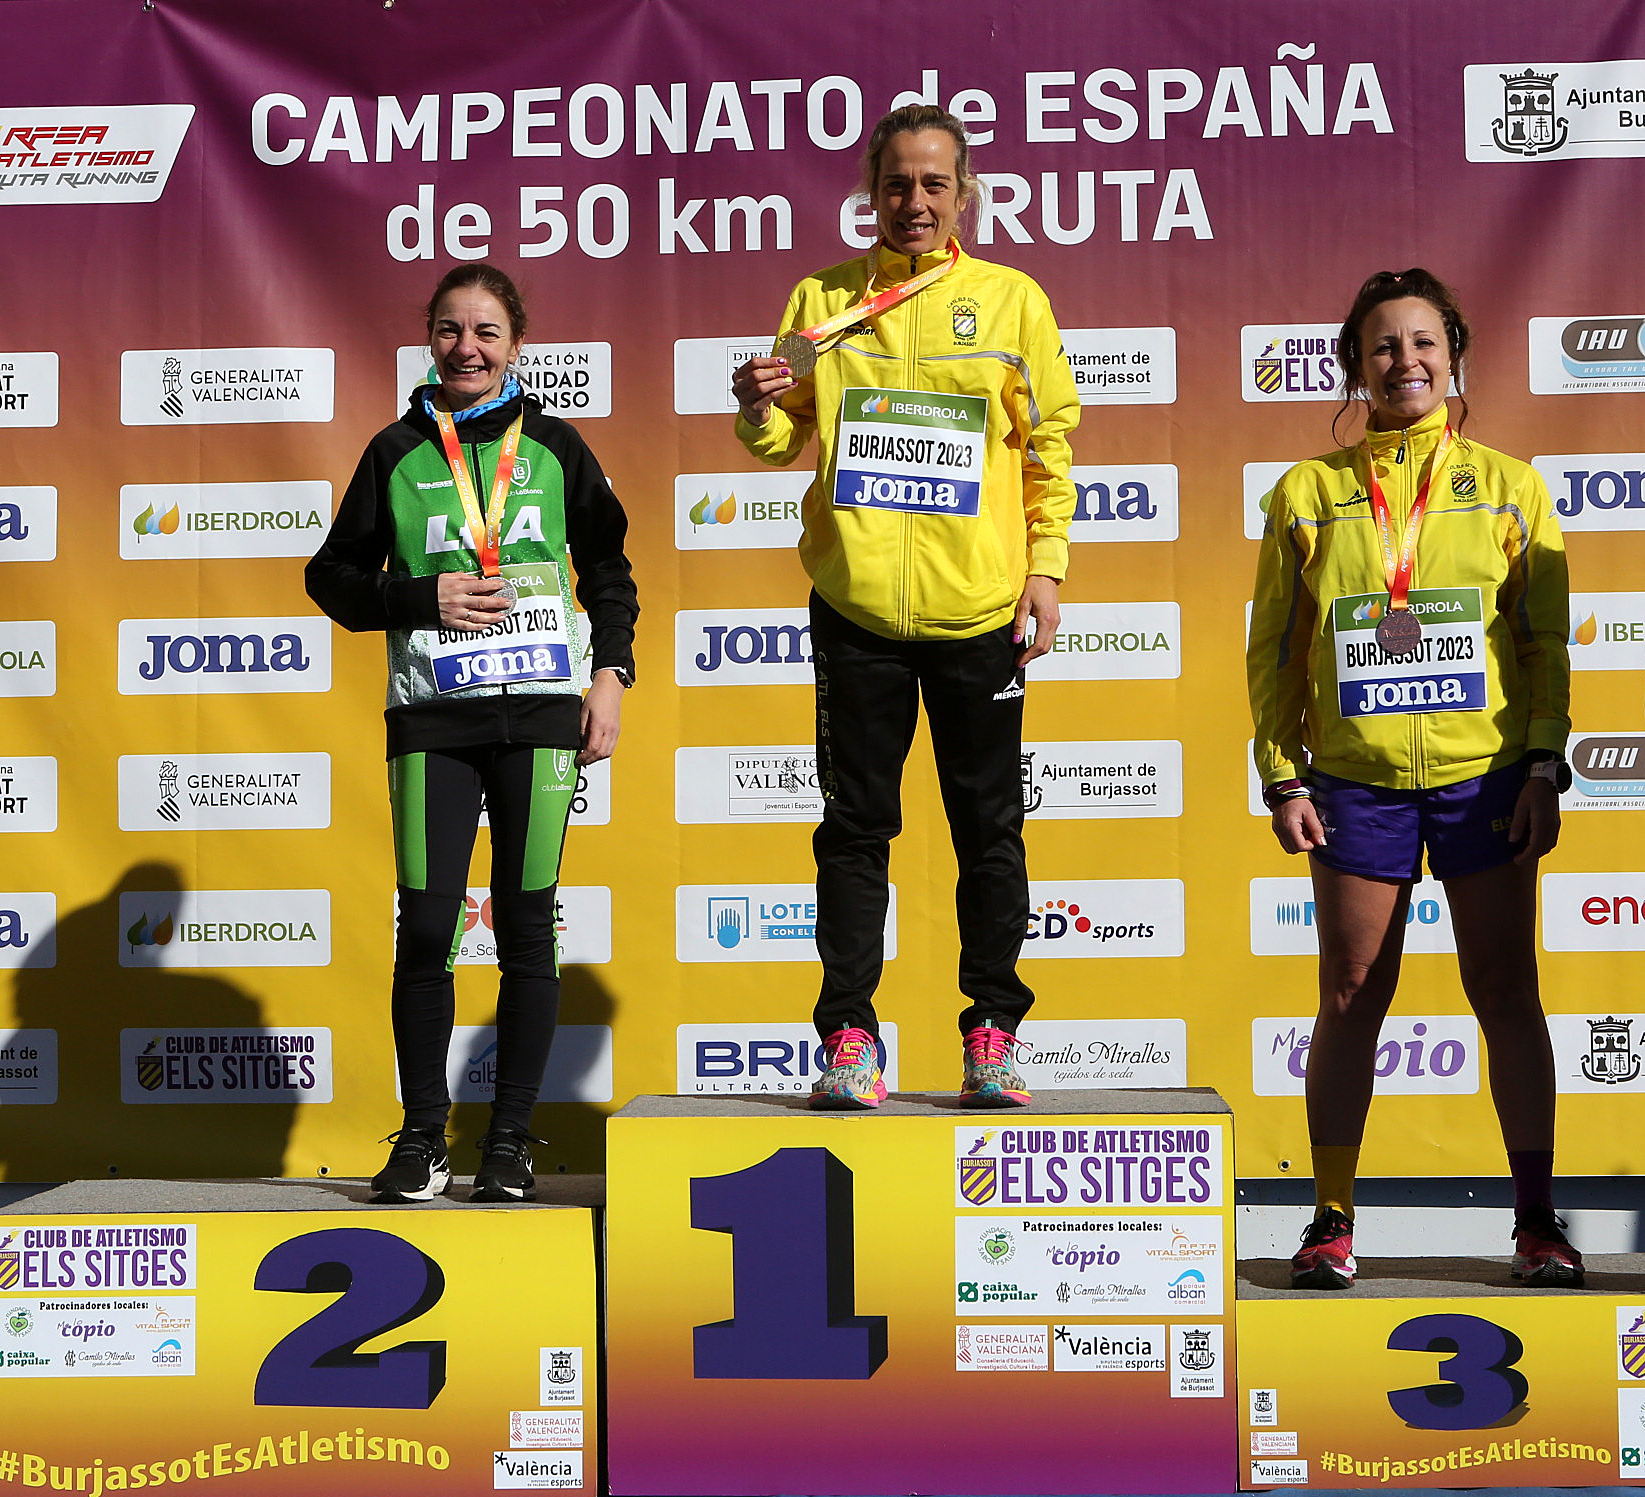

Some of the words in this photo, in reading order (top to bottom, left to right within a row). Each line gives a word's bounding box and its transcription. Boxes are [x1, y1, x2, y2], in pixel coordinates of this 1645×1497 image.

[251, 75, 863, 167] CAMPEONATO
[1025, 42, 1395, 144] ESPAÑA
[2, 125, 110, 151] RFEA
[56, 171, 159, 189] RUNNING
[386, 184, 492, 263] de
[518, 183, 630, 260] 50
[658, 178, 794, 255] km
[976, 168, 1215, 246] RUTA
[1285, 338, 1327, 355] CLUB
[1576, 328, 1628, 351] IAU
[519, 351, 589, 366] DACIÓN
[1067, 350, 1127, 366] ntament
[1131, 350, 1150, 365] de
[190, 369, 304, 384] GENERALITAT
[1075, 370, 1151, 388] Burjassot
[1285, 357, 1335, 392] ELS
[191, 386, 301, 402] VALENCIANA
[891, 402, 969, 421] IBERDROLA
[848, 433, 935, 464] BURJASSOT
[936, 441, 973, 468] 2023
[1071, 480, 1158, 522] ma
[186, 510, 323, 532] IBERDROLA
[525, 608, 558, 633] 2023
[695, 624, 814, 672] Jom
[1028, 631, 1171, 653] IERDROLA
[1437, 635, 1474, 662] 2023
[1587, 747, 1640, 769] IAU
[735, 770, 820, 789] VALÈNC
[1041, 763, 1132, 782] Ajuntament
[1137, 762, 1157, 777] de
[187, 774, 301, 789] GENERALITAT
[189, 791, 298, 807] VALENCIANA
[1080, 782, 1157, 800] Burjassot
[764, 802, 790, 811] Joventut
[795, 802, 818, 811] Esports
[760, 903, 816, 920] LOTE
[180, 922, 317, 943] IBERDROLA
[772, 928, 794, 936] CON
[1092, 922, 1155, 942] sports
[20, 1046, 38, 1061] de
[166, 1036, 205, 1054] CLUB
[209, 1036, 228, 1054] DE
[231, 1035, 315, 1053] ATLETISMO
[1016, 1042, 1082, 1065] Camilo
[1088, 1041, 1171, 1064] Miralles
[166, 1055, 214, 1090] ELS
[221, 1054, 316, 1089] SITGES
[1093, 1066, 1106, 1080] de
[1108, 1066, 1135, 1080] seda
[695, 1082, 803, 1092] ULTRASO
[1001, 1130, 1057, 1154] CLUB
[1063, 1130, 1089, 1153] DE
[1094, 1129, 1210, 1153] ATLETISMO
[962, 1158, 995, 1168] BURJASSOT
[1001, 1157, 1068, 1204] ELS
[1080, 1156, 1211, 1203] SITGES
[1022, 1220, 1114, 1232] Patrocinadores
[1118, 1220, 1163, 1232] locales:
[24, 1229, 67, 1248] CLUB
[72, 1229, 91, 1247] DE
[96, 1227, 187, 1247] ATLETISMO
[1051, 1243, 1121, 1273] copio
[1145, 1249, 1177, 1257] VITAL
[1178, 1249, 1217, 1257] SPORT
[23, 1249, 76, 1288] ELS
[85, 1248, 187, 1287] SITGES
[690, 1146, 889, 1380] 1
[982, 1281, 1018, 1292] caixa
[1073, 1284, 1105, 1296] Camilo
[1107, 1283, 1147, 1296] Miralles
[1168, 1285, 1206, 1299] alban
[39, 1301, 111, 1311] Patrocinadores
[113, 1300, 149, 1310] locales:
[982, 1291, 1039, 1303] popular
[254, 1227, 447, 1409] 2
[61, 1319, 116, 1343] copio
[975, 1334, 1046, 1344] GENERALITAT
[7, 1349, 35, 1358] caixa
[976, 1345, 1044, 1354] VALENCIANA
[1068, 1336, 1152, 1356] València
[7, 1357, 51, 1367] popular
[152, 1351, 182, 1363] alban
[1125, 1358, 1165, 1371] esports
[1180, 1376, 1214, 1385] Ajuntament
[1387, 1313, 1529, 1430] 3
[1189, 1384, 1215, 1392] Burjassot
[525, 1417, 581, 1426] GENERALITAT
[526, 1426, 580, 1435] VALENCIANA
[0, 1427, 450, 1497] #BurjassotEsAtletismo
[506, 1460, 572, 1476] València
[1320, 1437, 1612, 1483] #BurjassotEsAtletismo
[1259, 1465, 1301, 1476] València
[550, 1478, 582, 1488] esports
